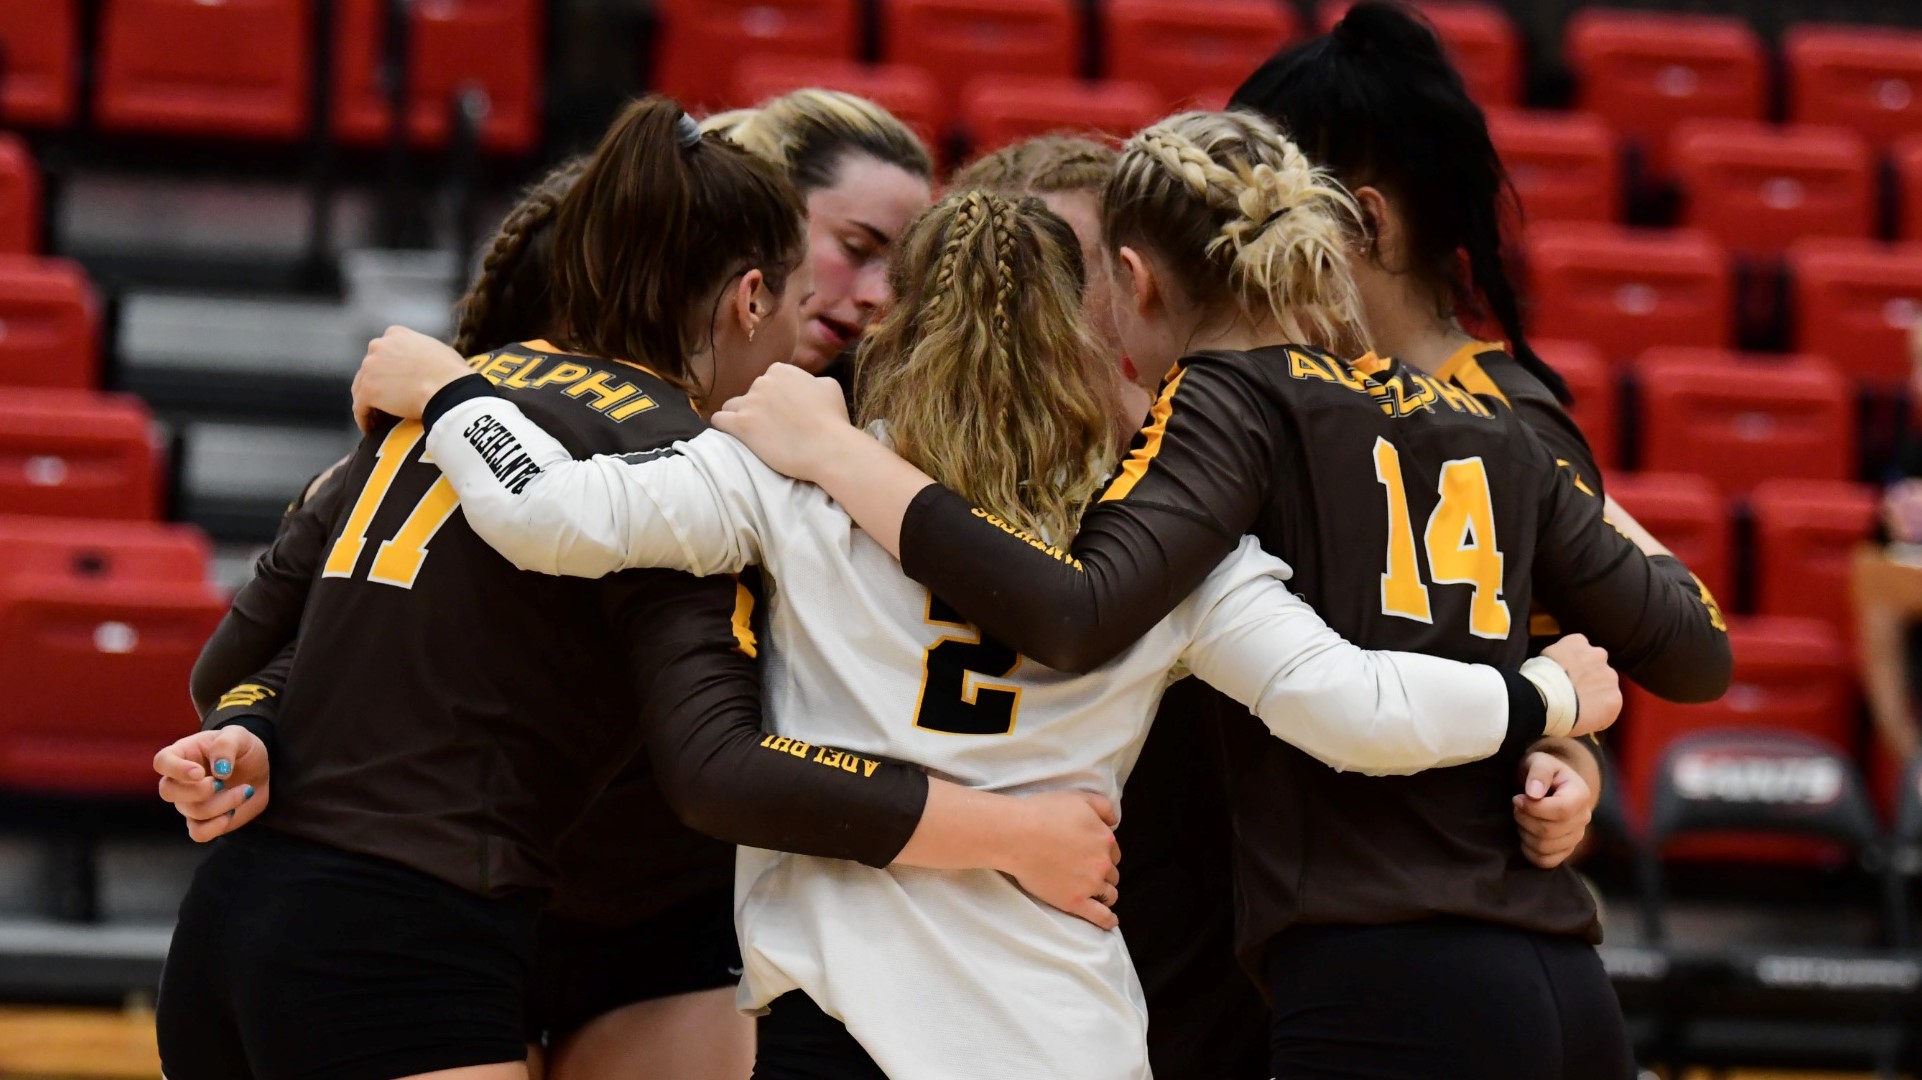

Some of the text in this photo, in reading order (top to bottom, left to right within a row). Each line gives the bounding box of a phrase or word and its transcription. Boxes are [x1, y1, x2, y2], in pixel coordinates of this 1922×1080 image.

[322, 419, 460, 589] 17
[1373, 435, 1511, 640] 14
[911, 588, 1022, 736] 2
[760, 734, 881, 778] ADELPHI
